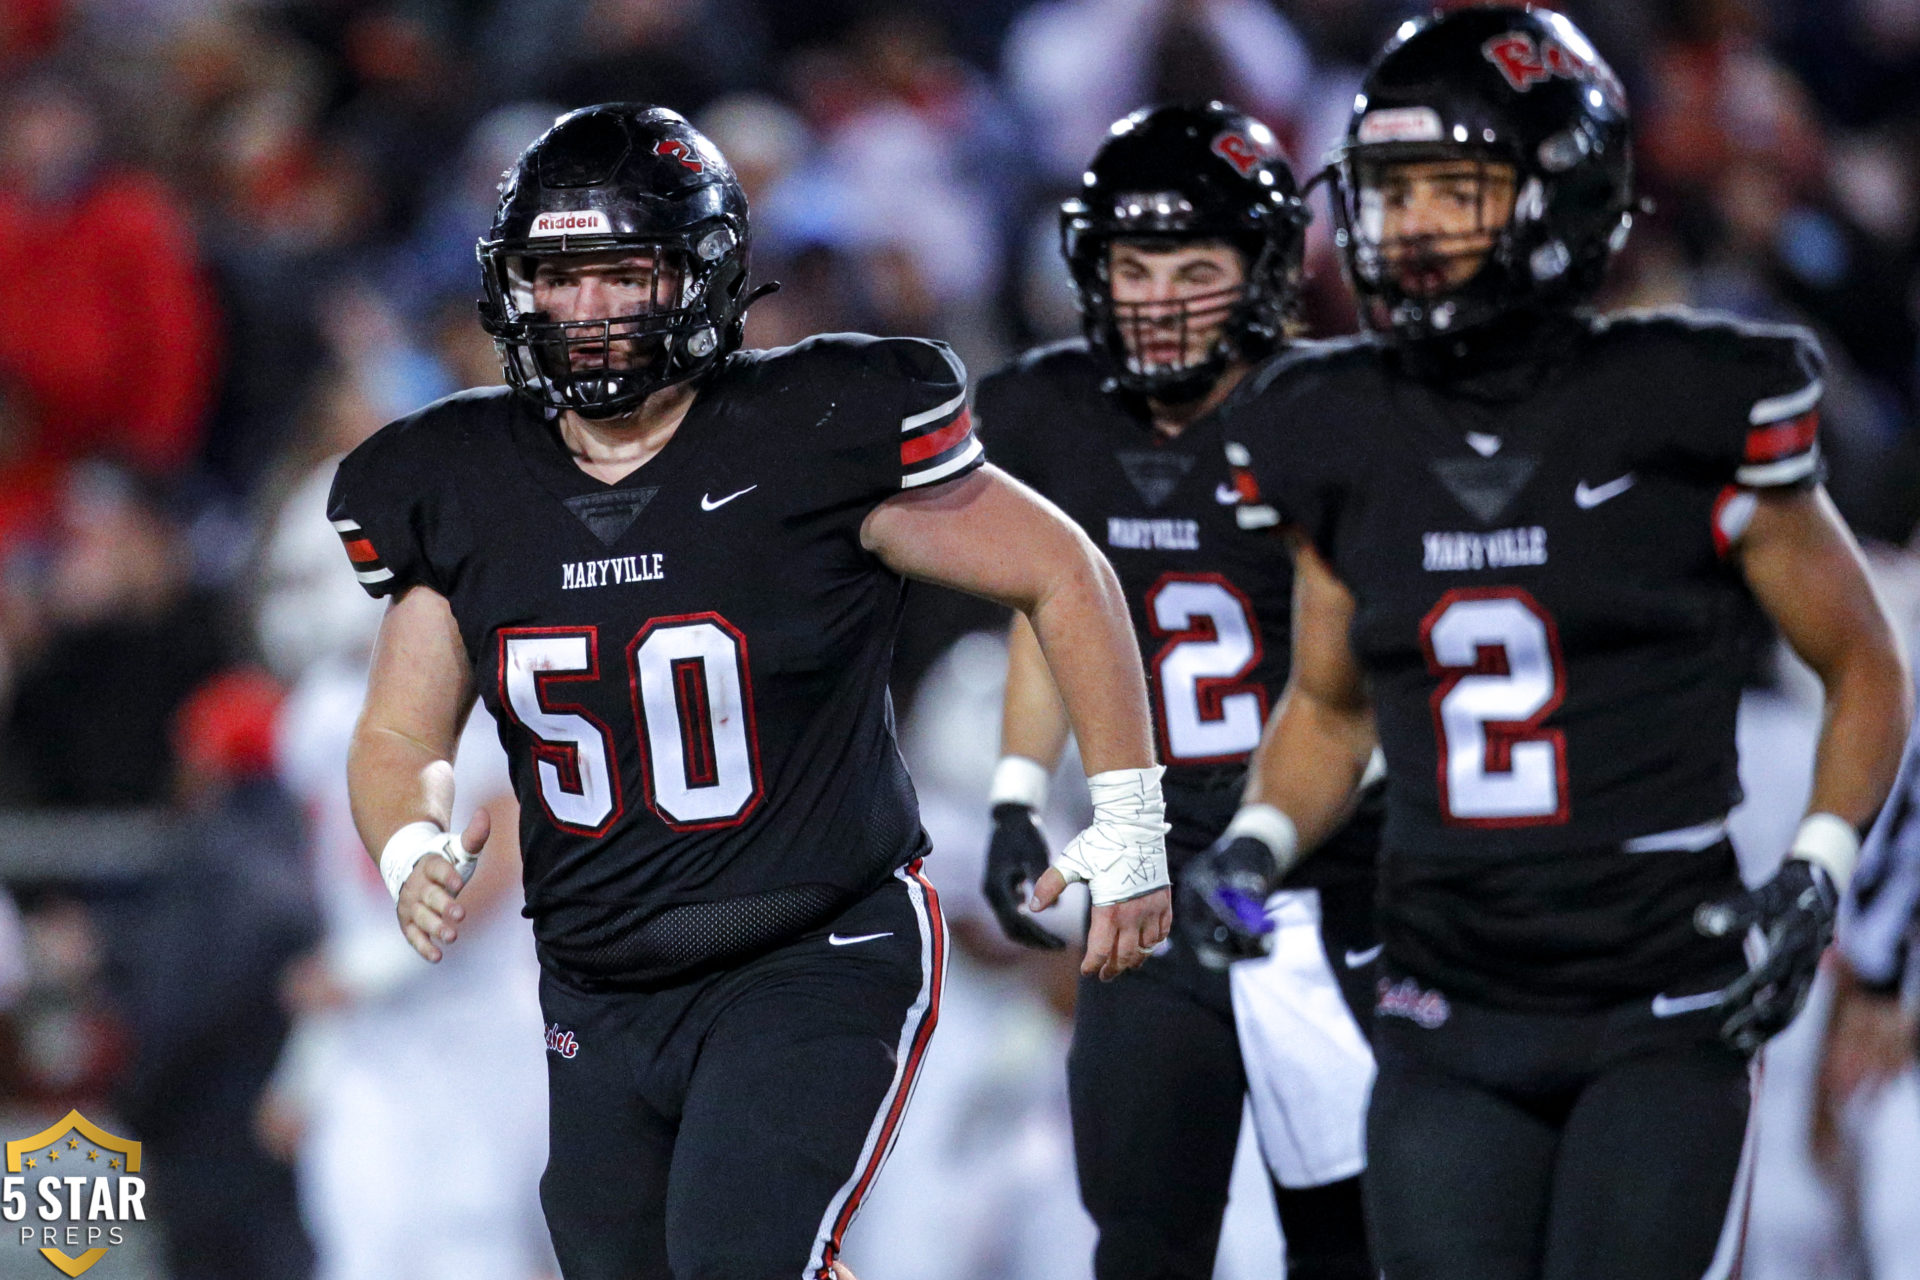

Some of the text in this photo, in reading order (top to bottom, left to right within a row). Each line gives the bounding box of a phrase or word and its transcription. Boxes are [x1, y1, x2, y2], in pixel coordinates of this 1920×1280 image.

[538, 215, 599, 231] Riddell
[562, 553, 664, 590] MARYVILLE
[1422, 526, 1548, 571] MARYVILLE
[497, 611, 764, 838] 50
[1145, 571, 1269, 764] 2
[1419, 586, 1570, 829] 2
